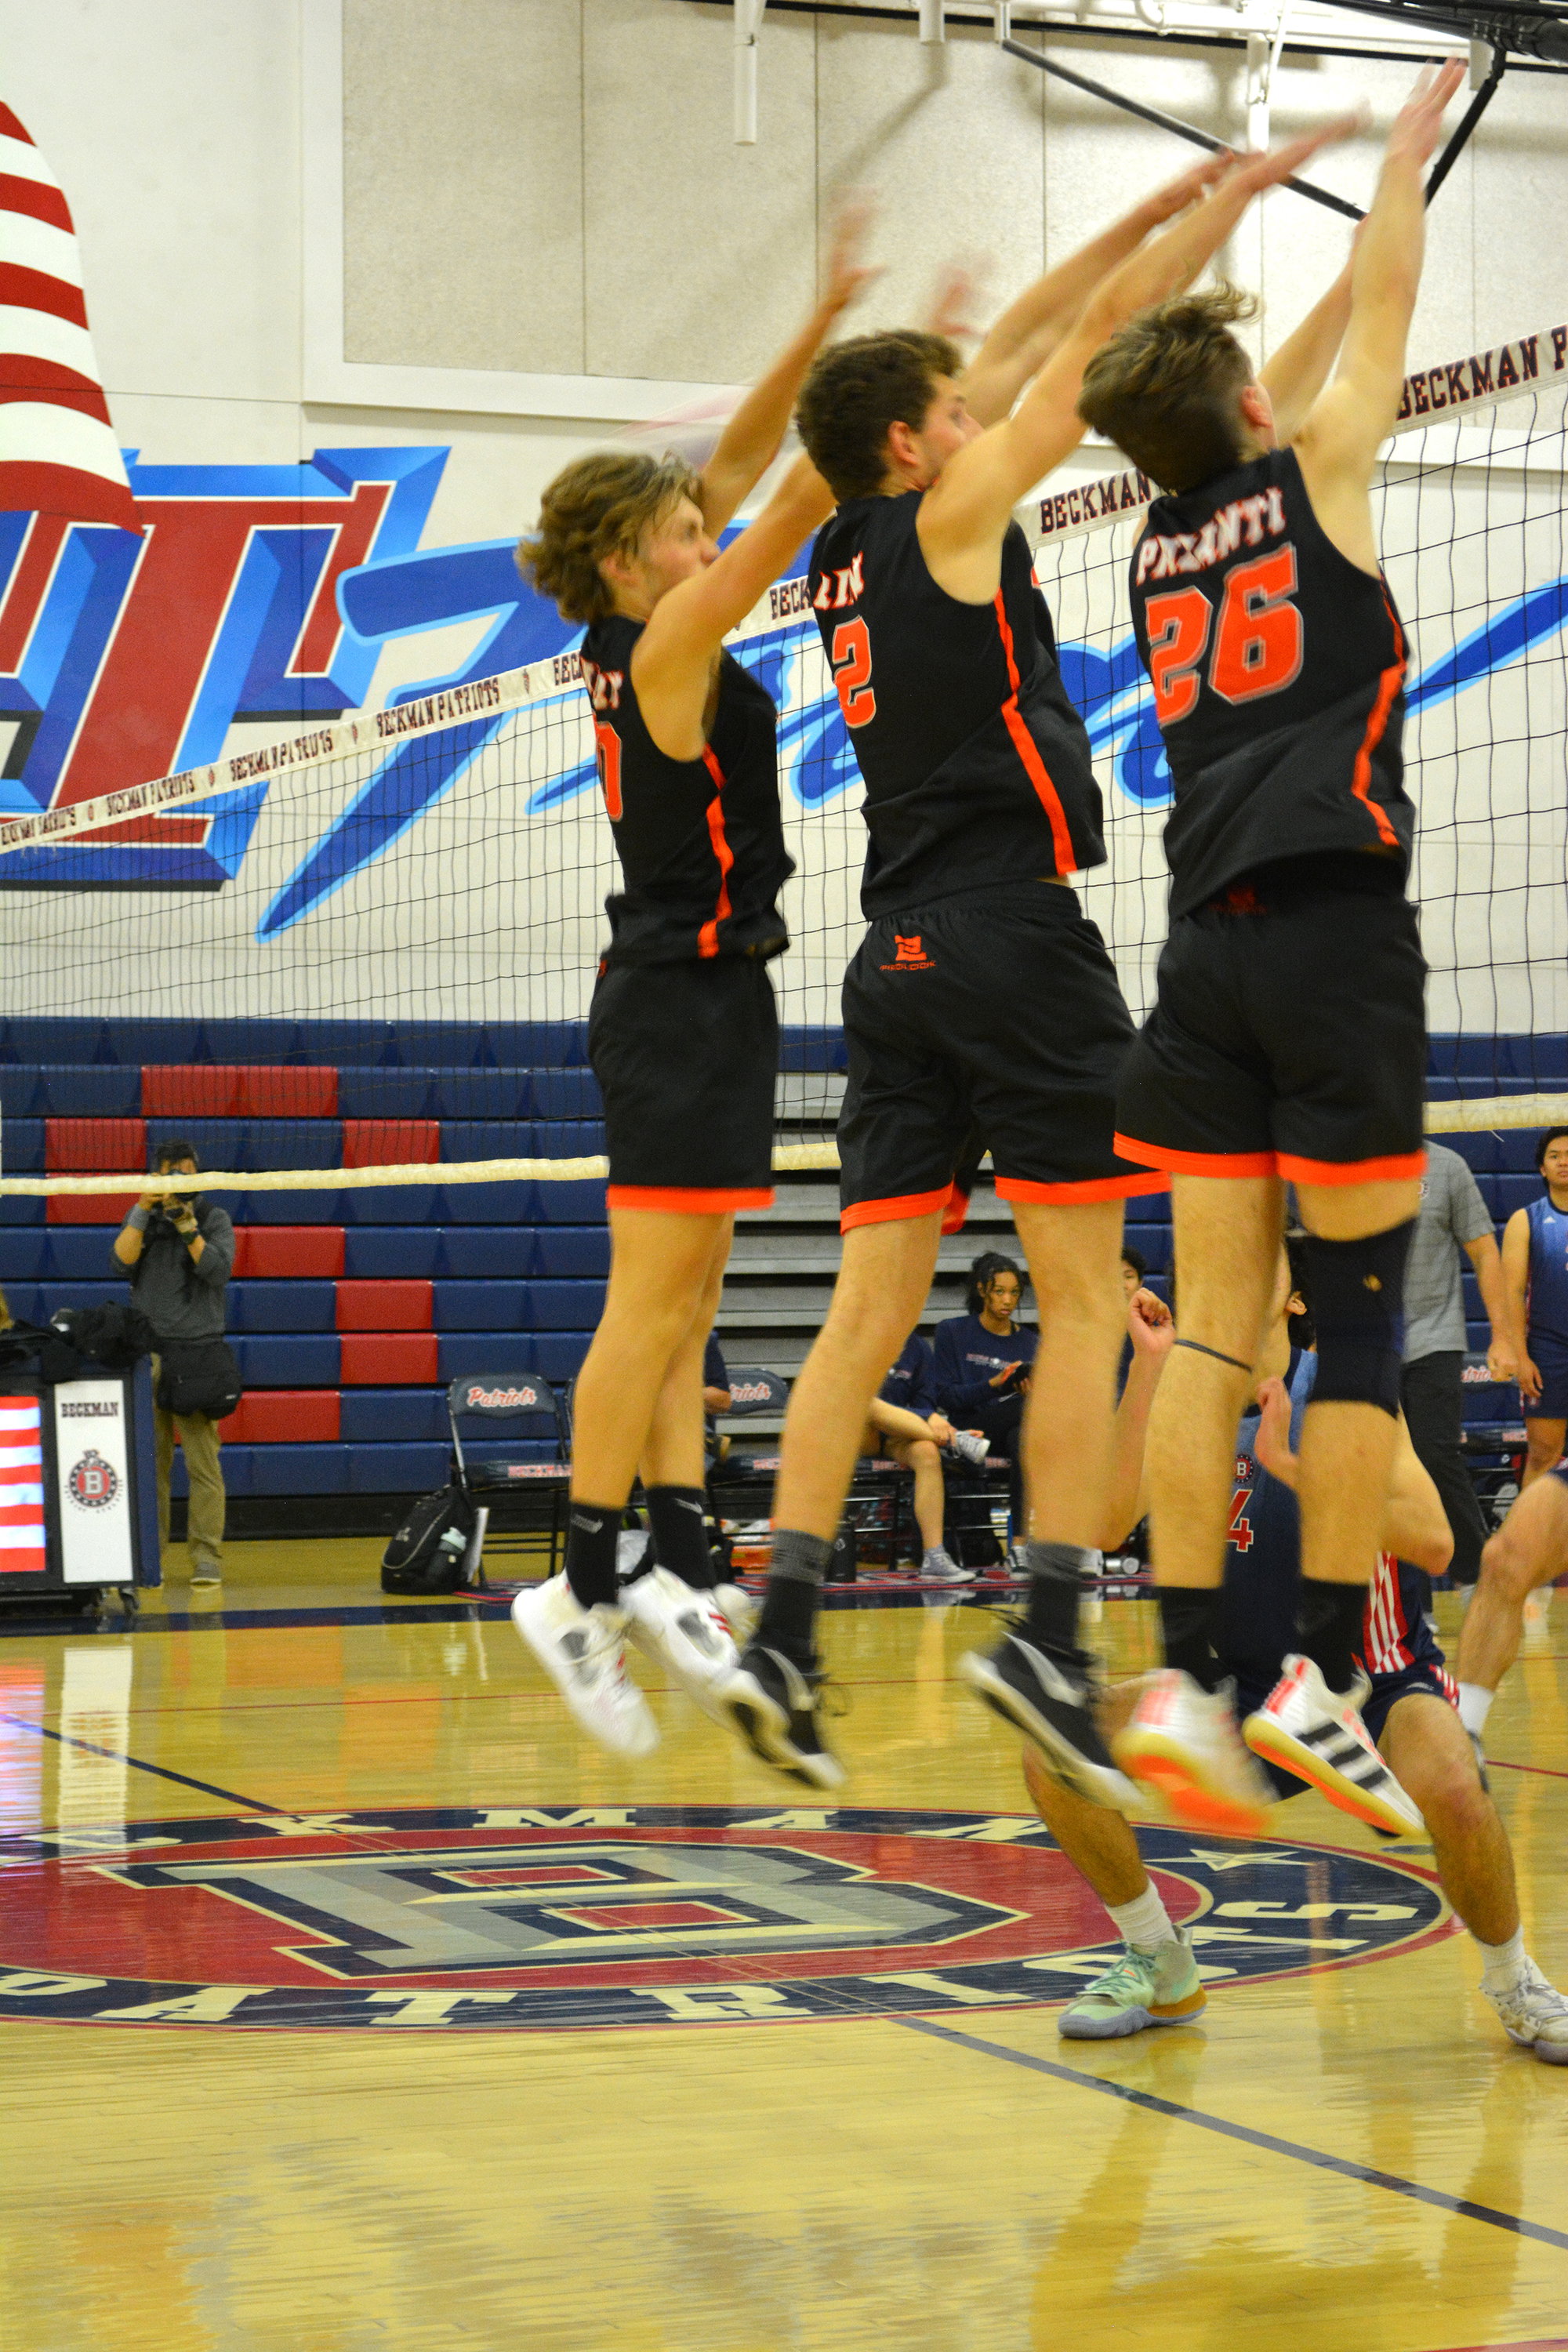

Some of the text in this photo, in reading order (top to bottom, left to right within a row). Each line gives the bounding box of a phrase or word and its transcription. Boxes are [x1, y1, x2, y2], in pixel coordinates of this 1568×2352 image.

[1040, 470, 1152, 535] BECKMAN
[1145, 540, 1305, 729] 26
[832, 614, 877, 728] 2
[376, 677, 501, 738] BECKMAN PATRIOTS
[61, 1402, 118, 1417] BECKMAN
[466, 1386, 538, 1408] Patriots
